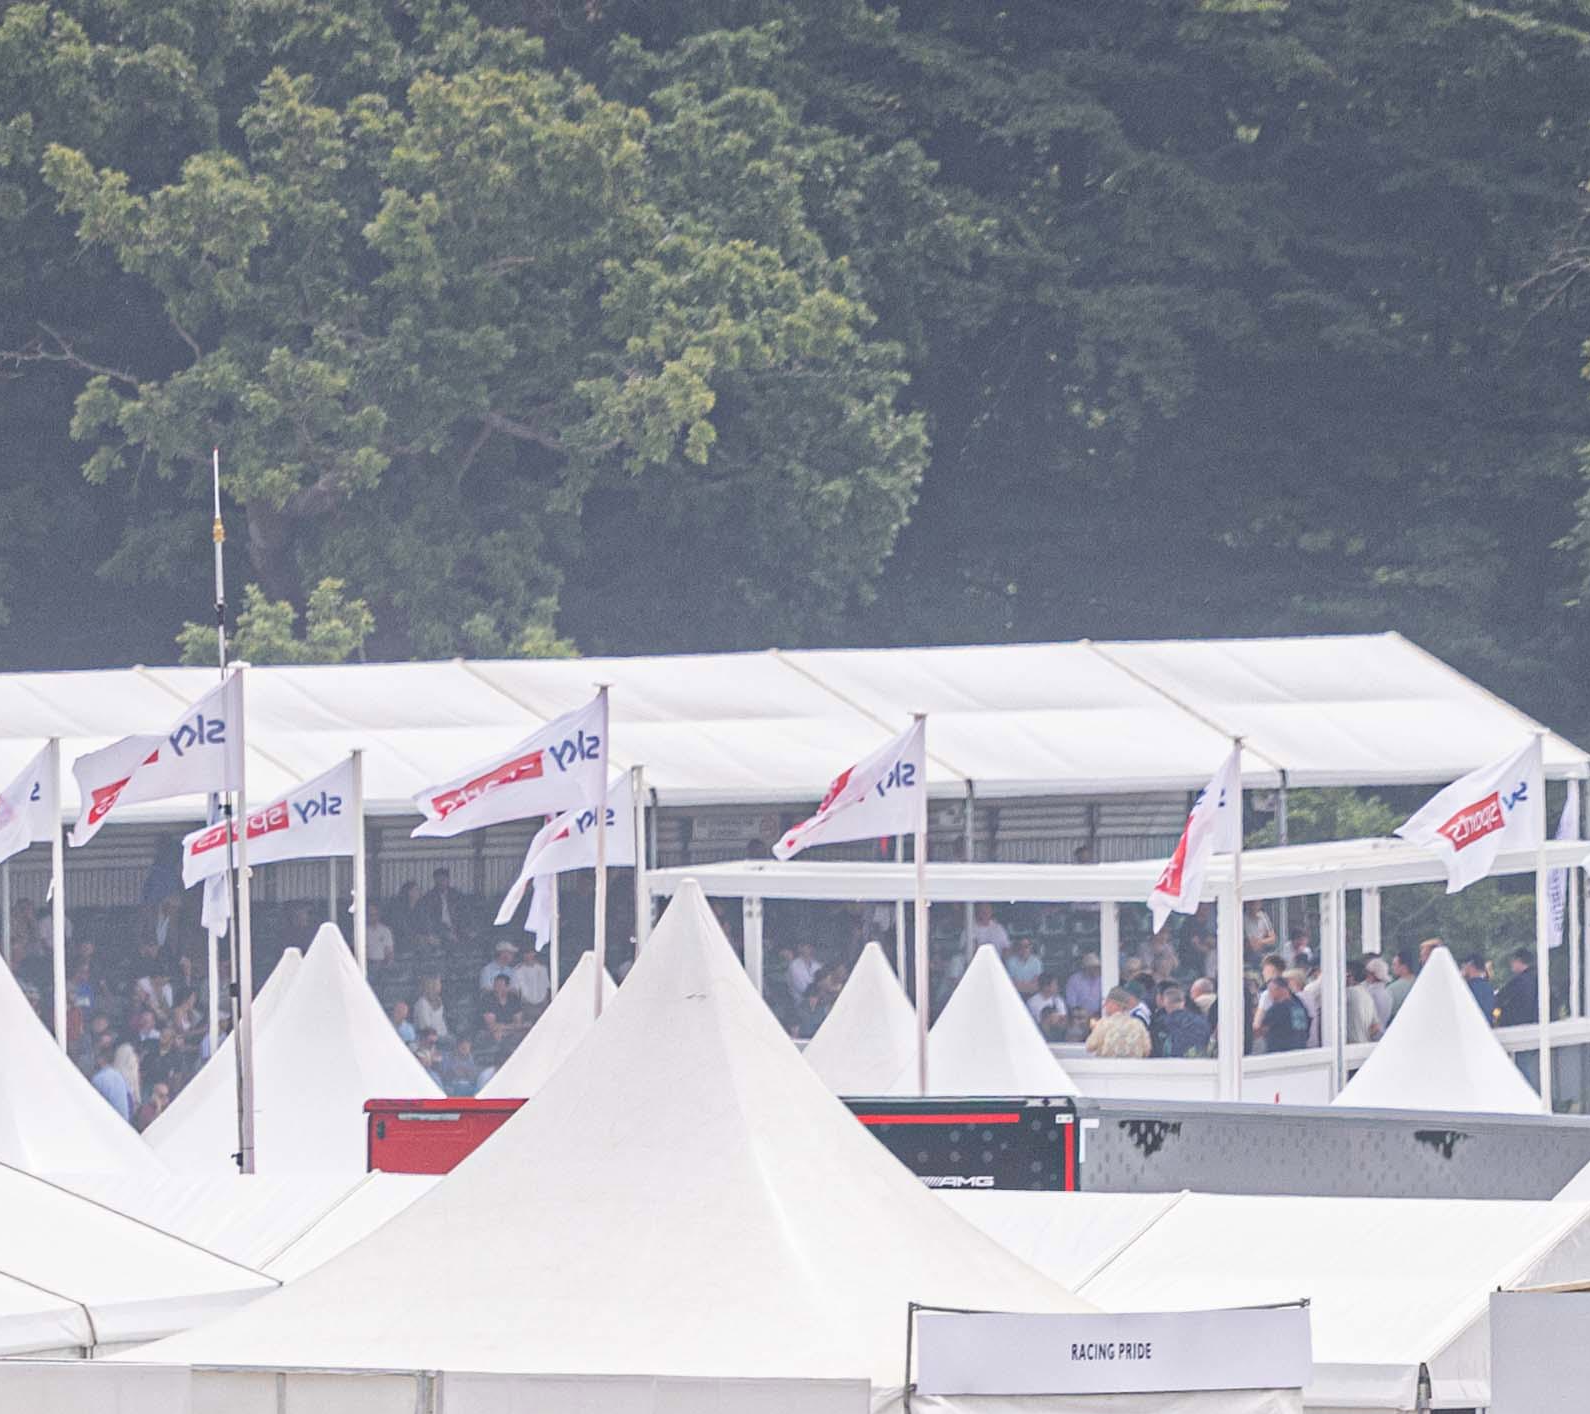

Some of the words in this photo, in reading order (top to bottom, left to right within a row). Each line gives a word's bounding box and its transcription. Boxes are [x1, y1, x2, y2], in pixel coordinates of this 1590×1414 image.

[939, 1175, 995, 1189] AMG
[1072, 1343, 1115, 1361] RACING
[1119, 1343, 1152, 1360] PRIDE
